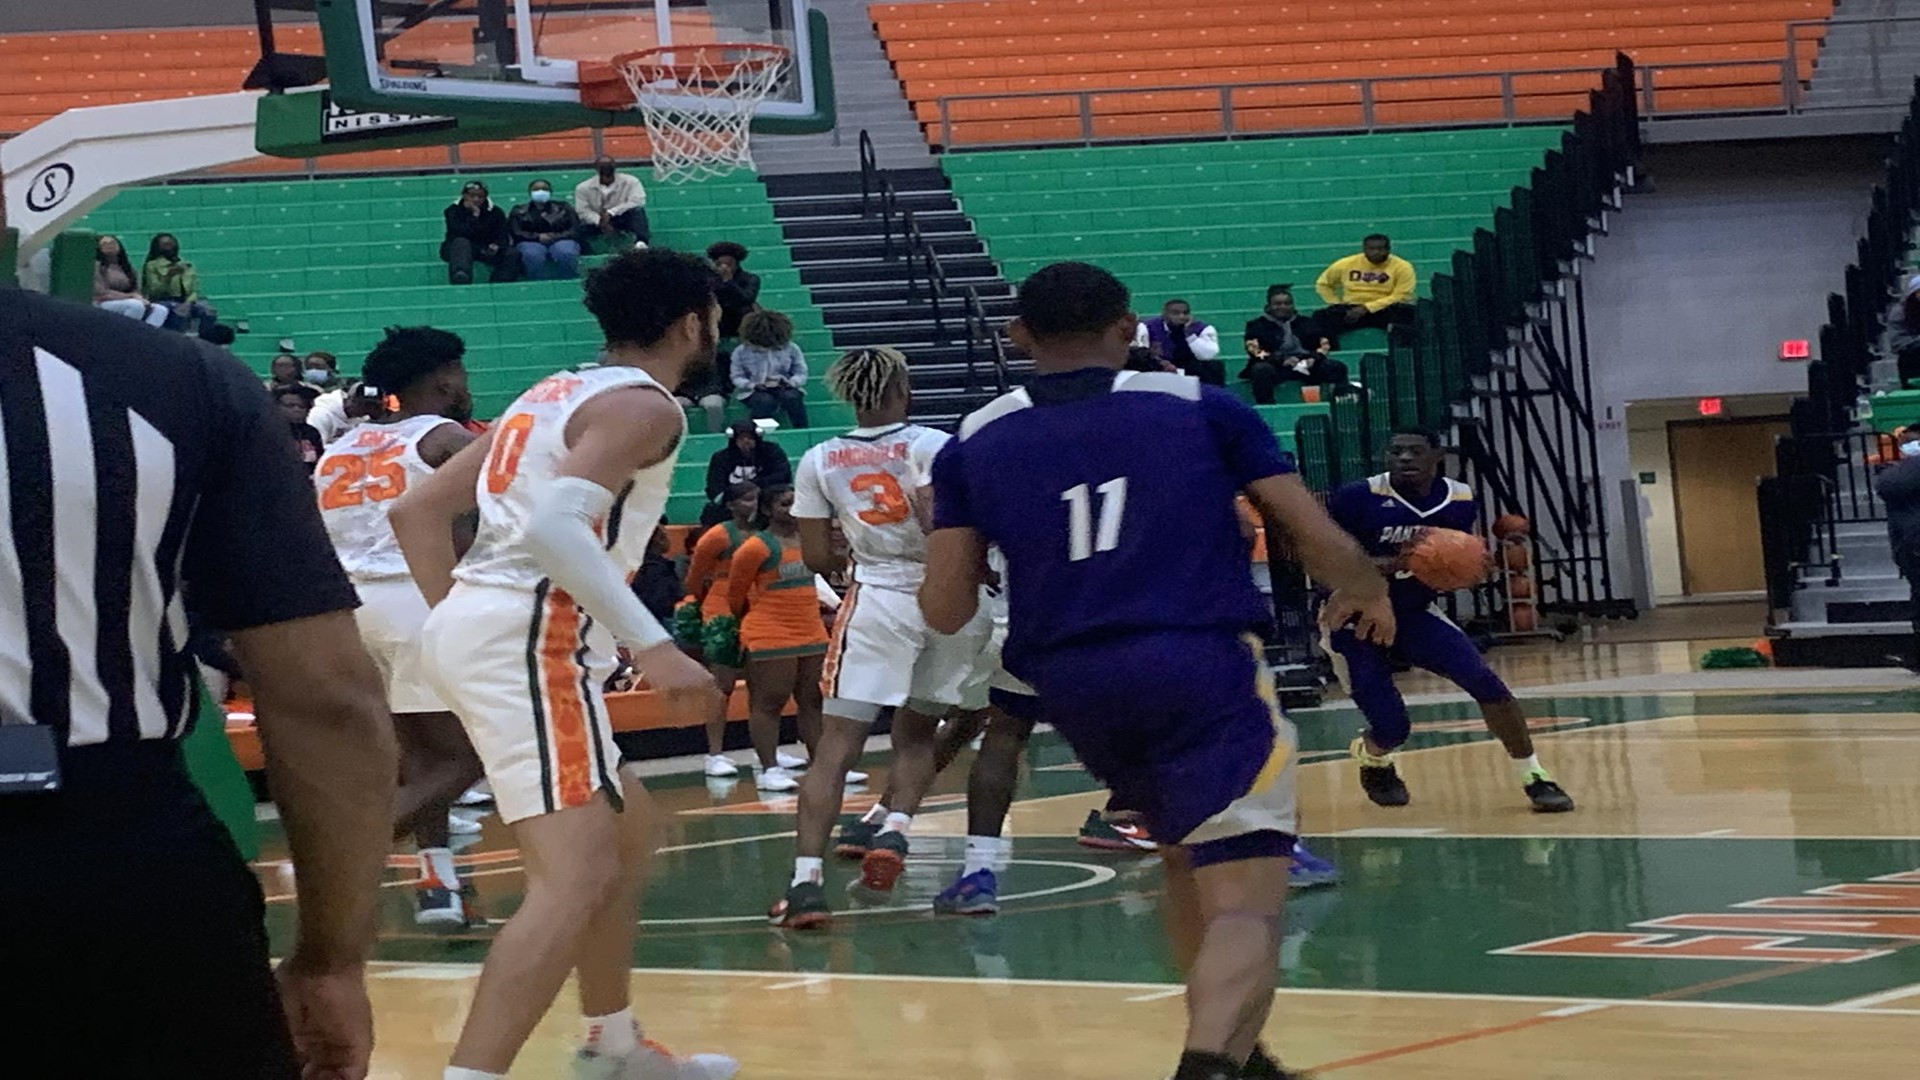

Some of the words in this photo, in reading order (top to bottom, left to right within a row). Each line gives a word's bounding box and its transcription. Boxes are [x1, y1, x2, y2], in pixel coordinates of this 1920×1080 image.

[379, 78, 428, 91] SPALDING
[335, 113, 422, 129] NISSA
[321, 444, 406, 510] 25
[849, 470, 909, 525] 3
[1060, 476, 1128, 561] 11
[1379, 525, 1424, 543] PANT
